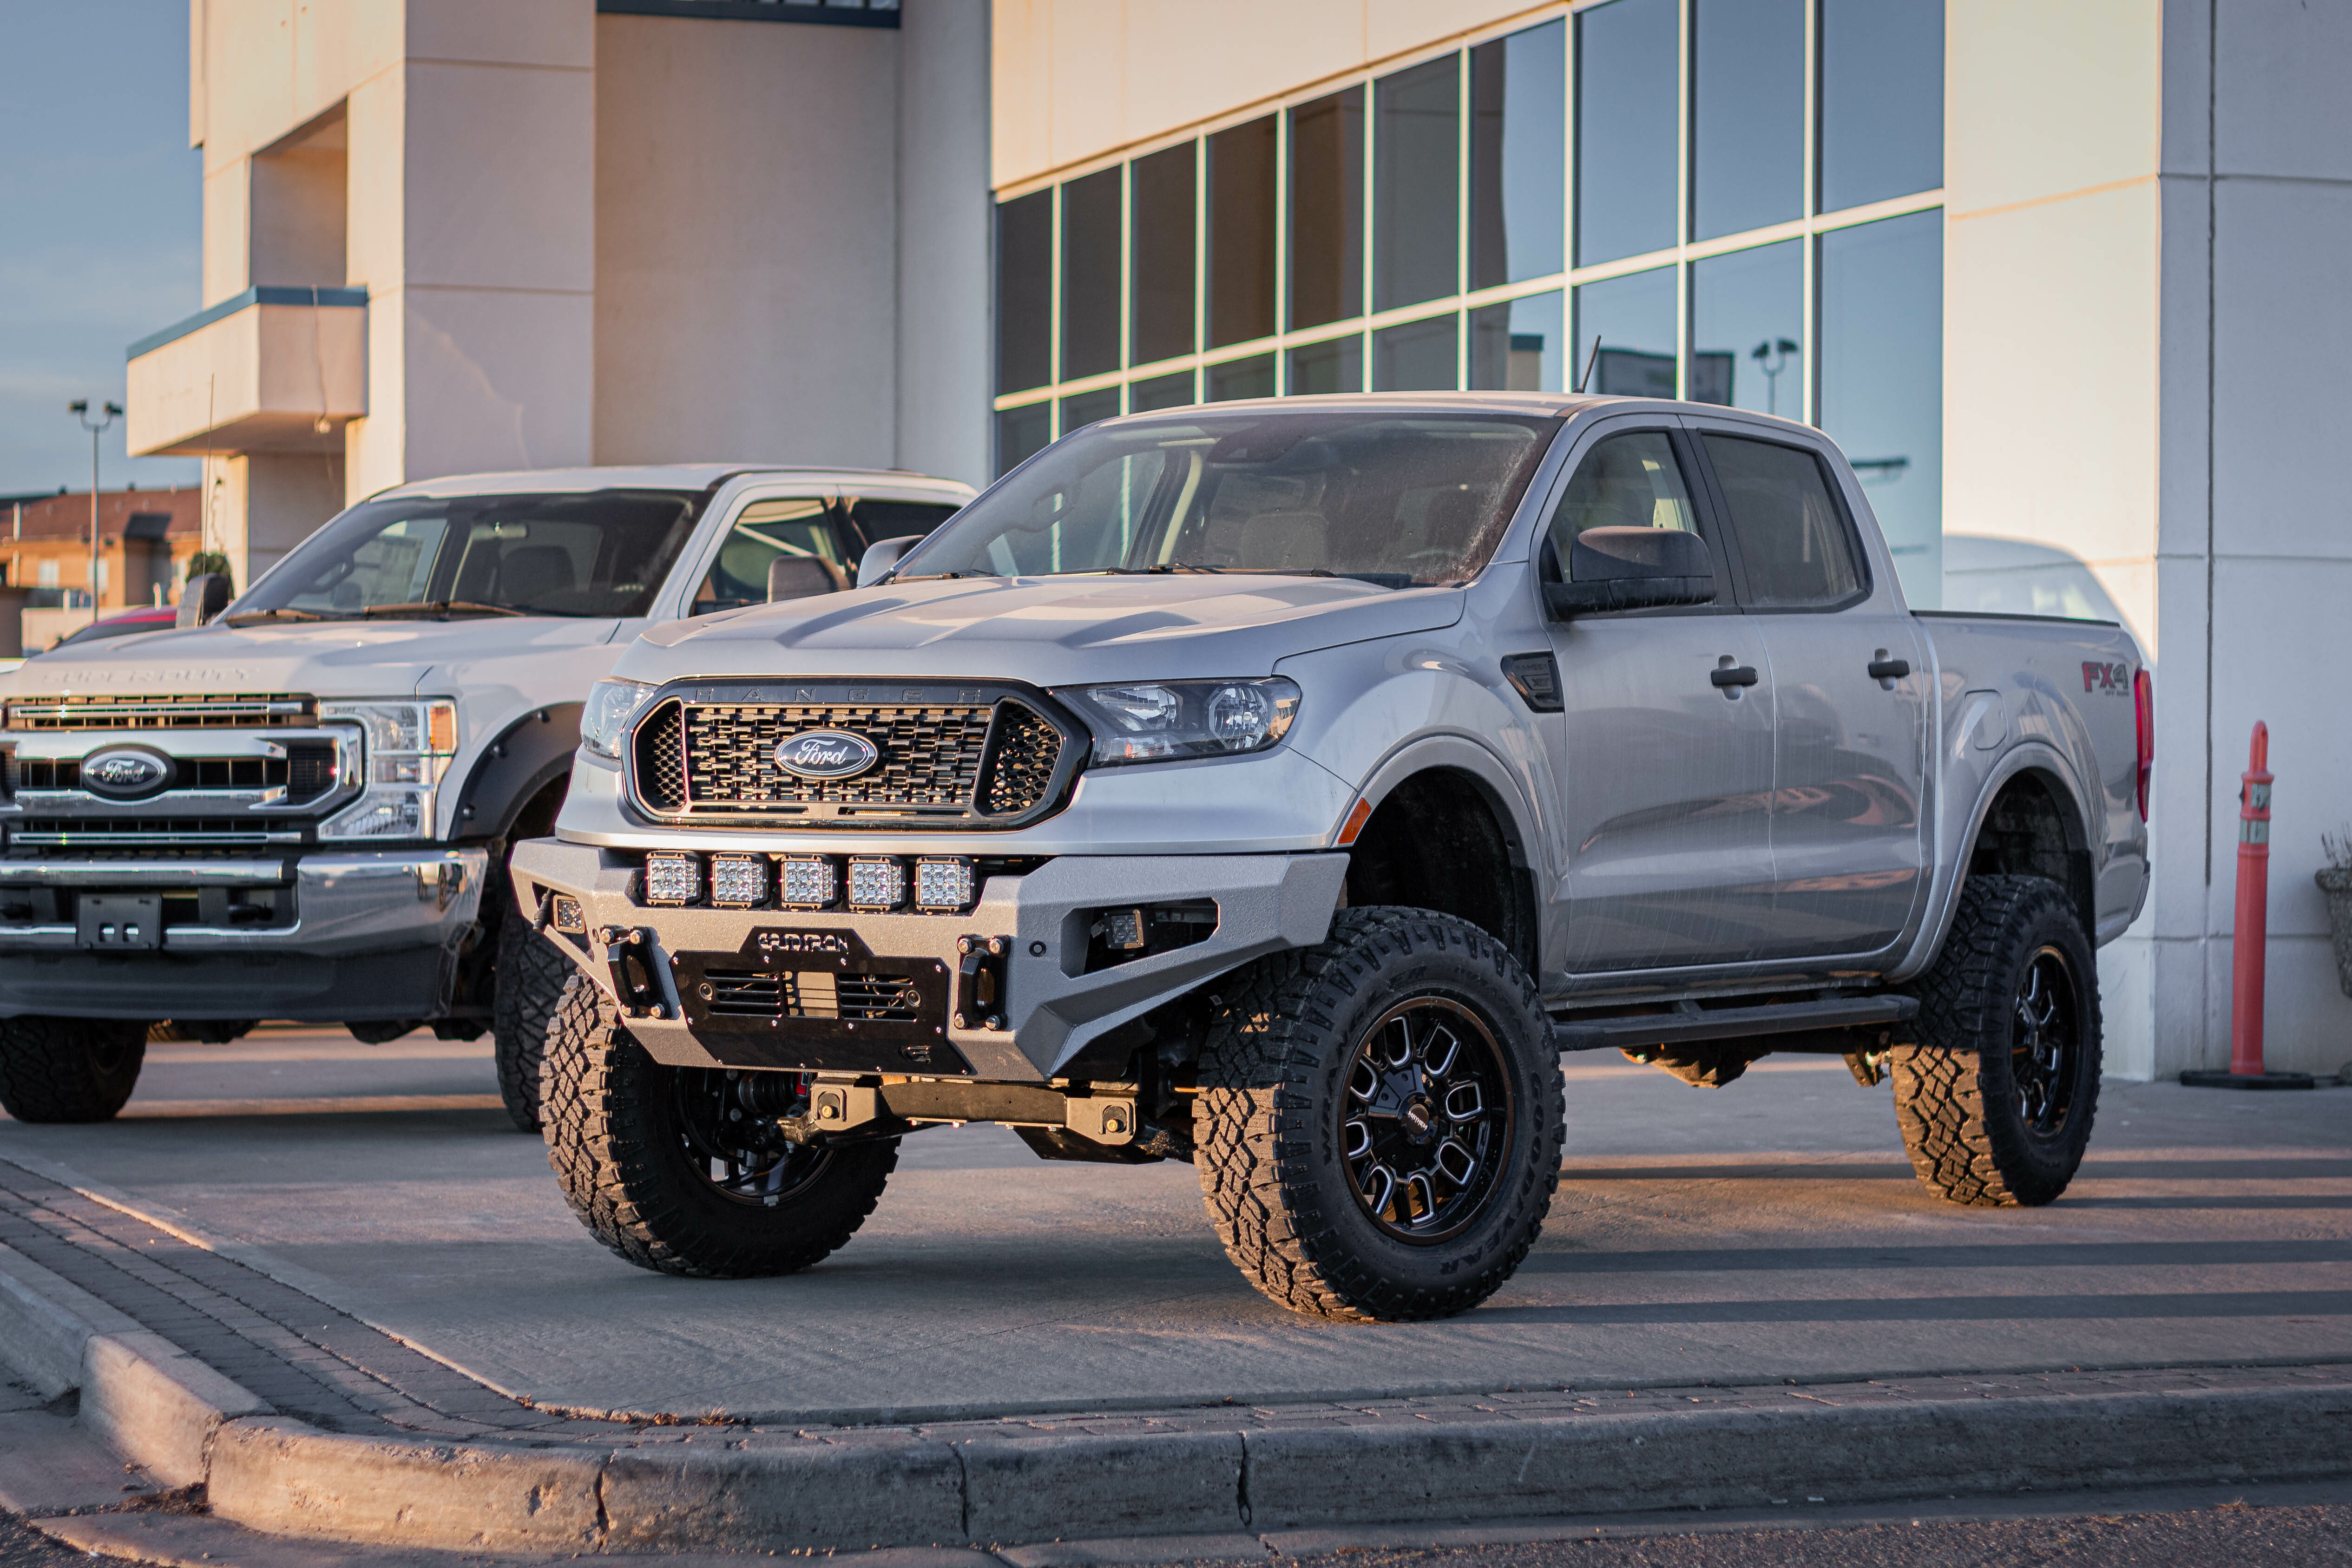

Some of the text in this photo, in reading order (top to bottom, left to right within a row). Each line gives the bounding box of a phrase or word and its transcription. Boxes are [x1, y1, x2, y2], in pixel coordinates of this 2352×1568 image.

[2082, 661, 2129, 692] FX4
[696, 688, 981, 702] RANGER
[795, 739, 848, 765] Ford
[102, 759, 145, 783] Ford
[758, 933, 848, 953] GRIDIRON
[1408, 1110, 1428, 1131] MAYHEM
[1440, 1071, 1544, 1274] GOODYEAR
